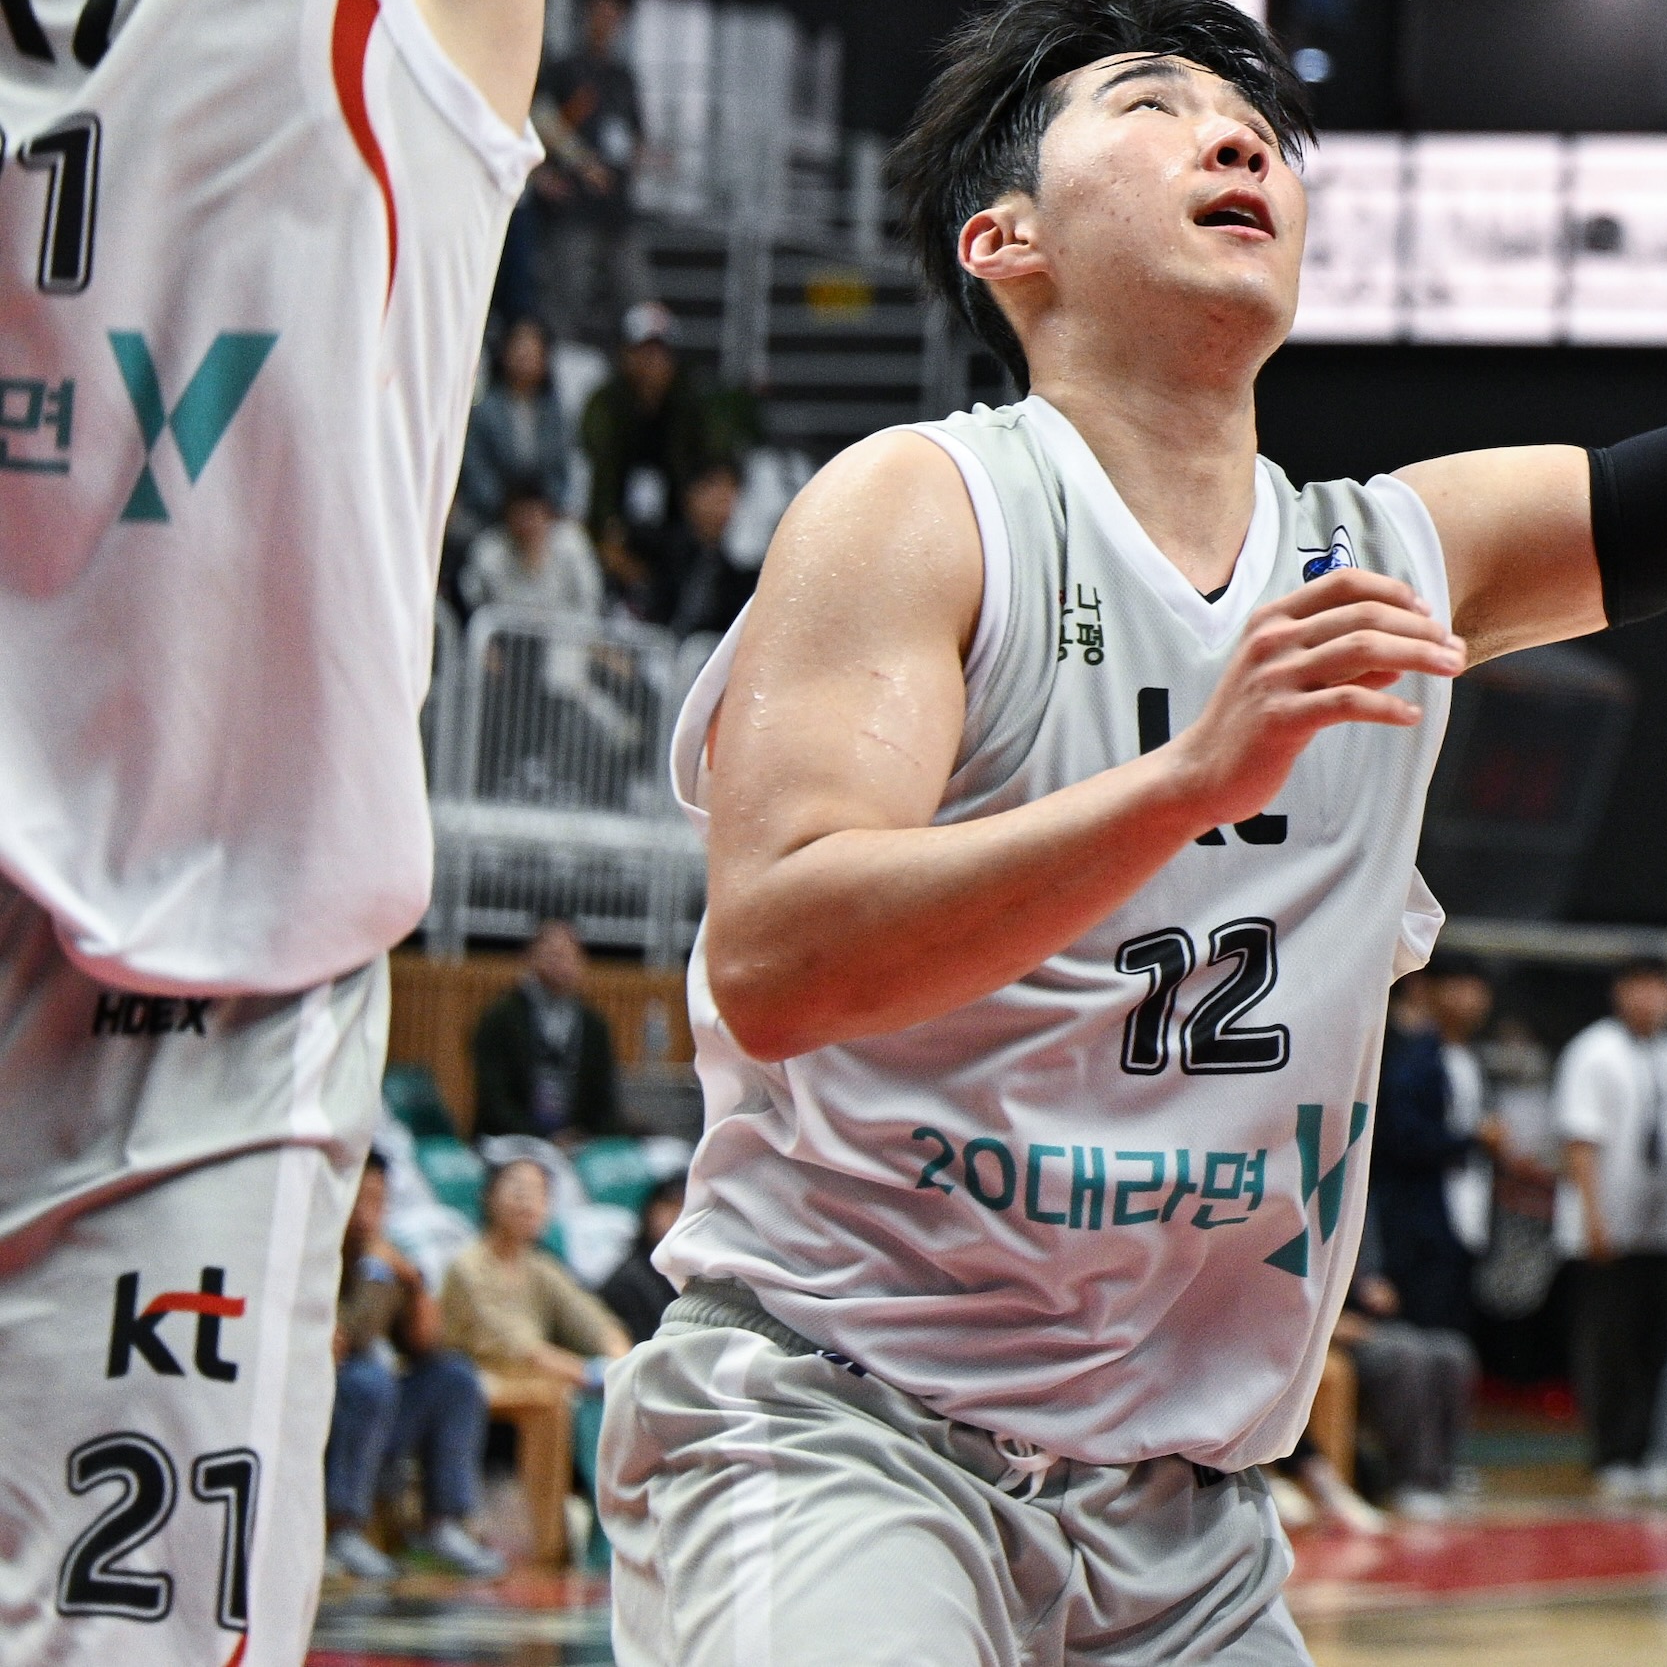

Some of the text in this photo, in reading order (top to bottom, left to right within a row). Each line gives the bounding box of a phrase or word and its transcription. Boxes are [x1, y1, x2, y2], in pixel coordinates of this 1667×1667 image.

[0, 112, 102, 296] 1
[93, 991, 210, 1038] HDEX
[1115, 917, 1290, 1076] 12
[911, 1125, 1268, 1233] 20대라면
[106, 1265, 246, 1383] kt
[57, 1431, 260, 1632] 21
